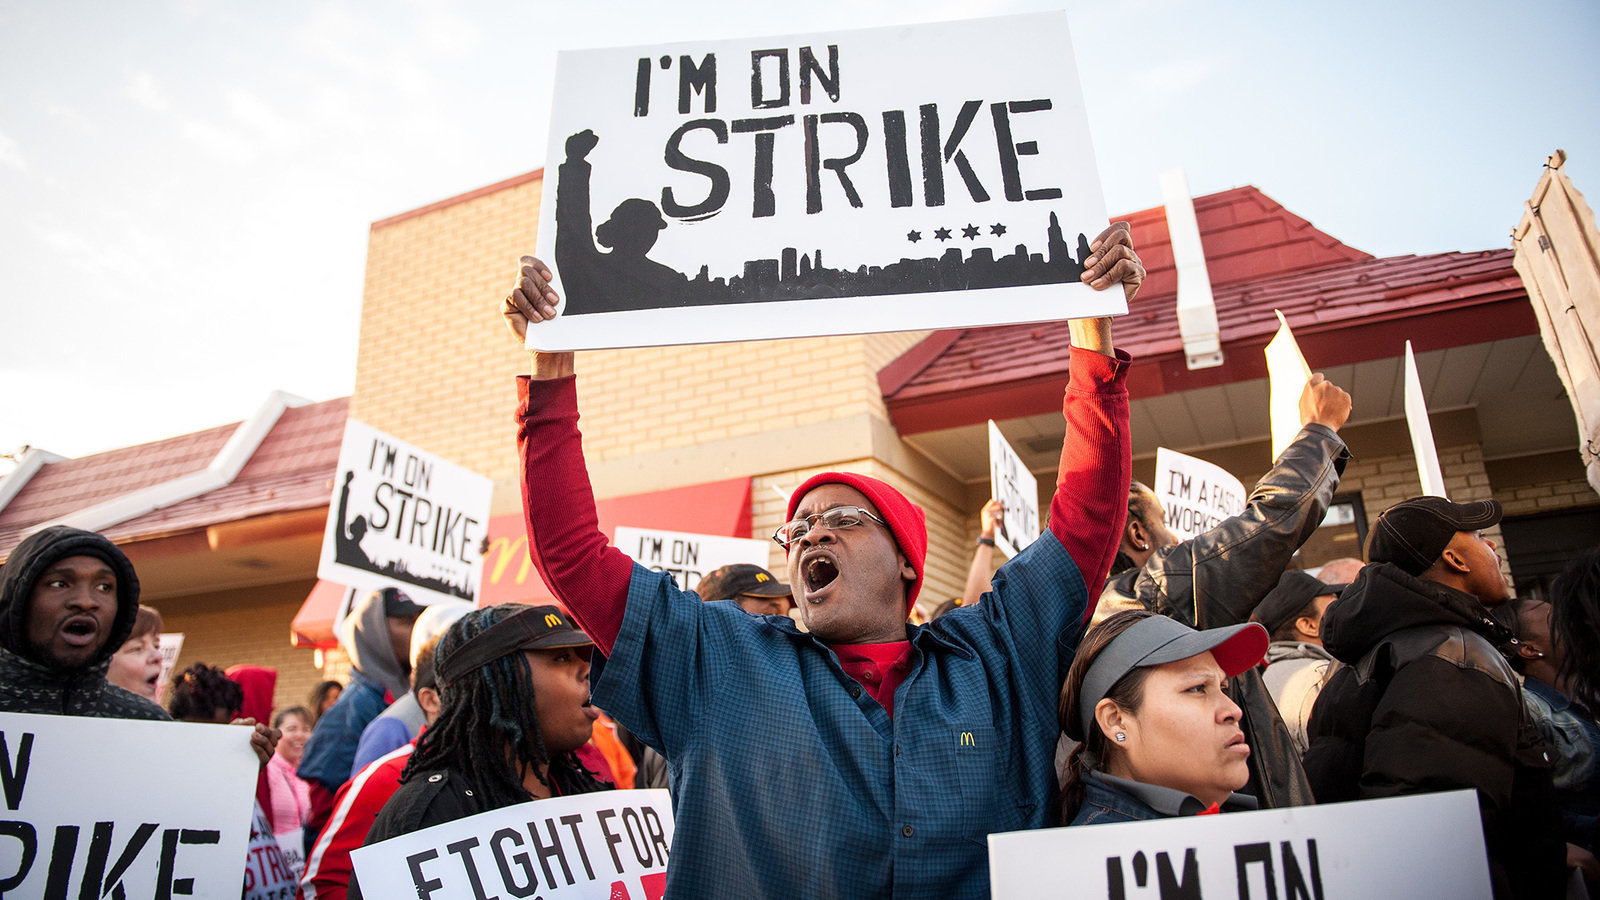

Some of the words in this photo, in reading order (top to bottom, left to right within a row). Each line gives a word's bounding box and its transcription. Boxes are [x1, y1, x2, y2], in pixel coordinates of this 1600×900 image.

[634, 52, 718, 117] I'M
[751, 44, 841, 110] ON
[661, 98, 1063, 222] STRIKE
[368, 438, 398, 479] I'M
[404, 453, 433, 492] ON
[1167, 469, 1192, 501] I'M
[1198, 479, 1209, 506] A
[369, 481, 479, 565] STRIKE
[638, 535, 664, 563] I'M
[672, 539, 700, 566] ON
[596, 805, 670, 875] FOR
